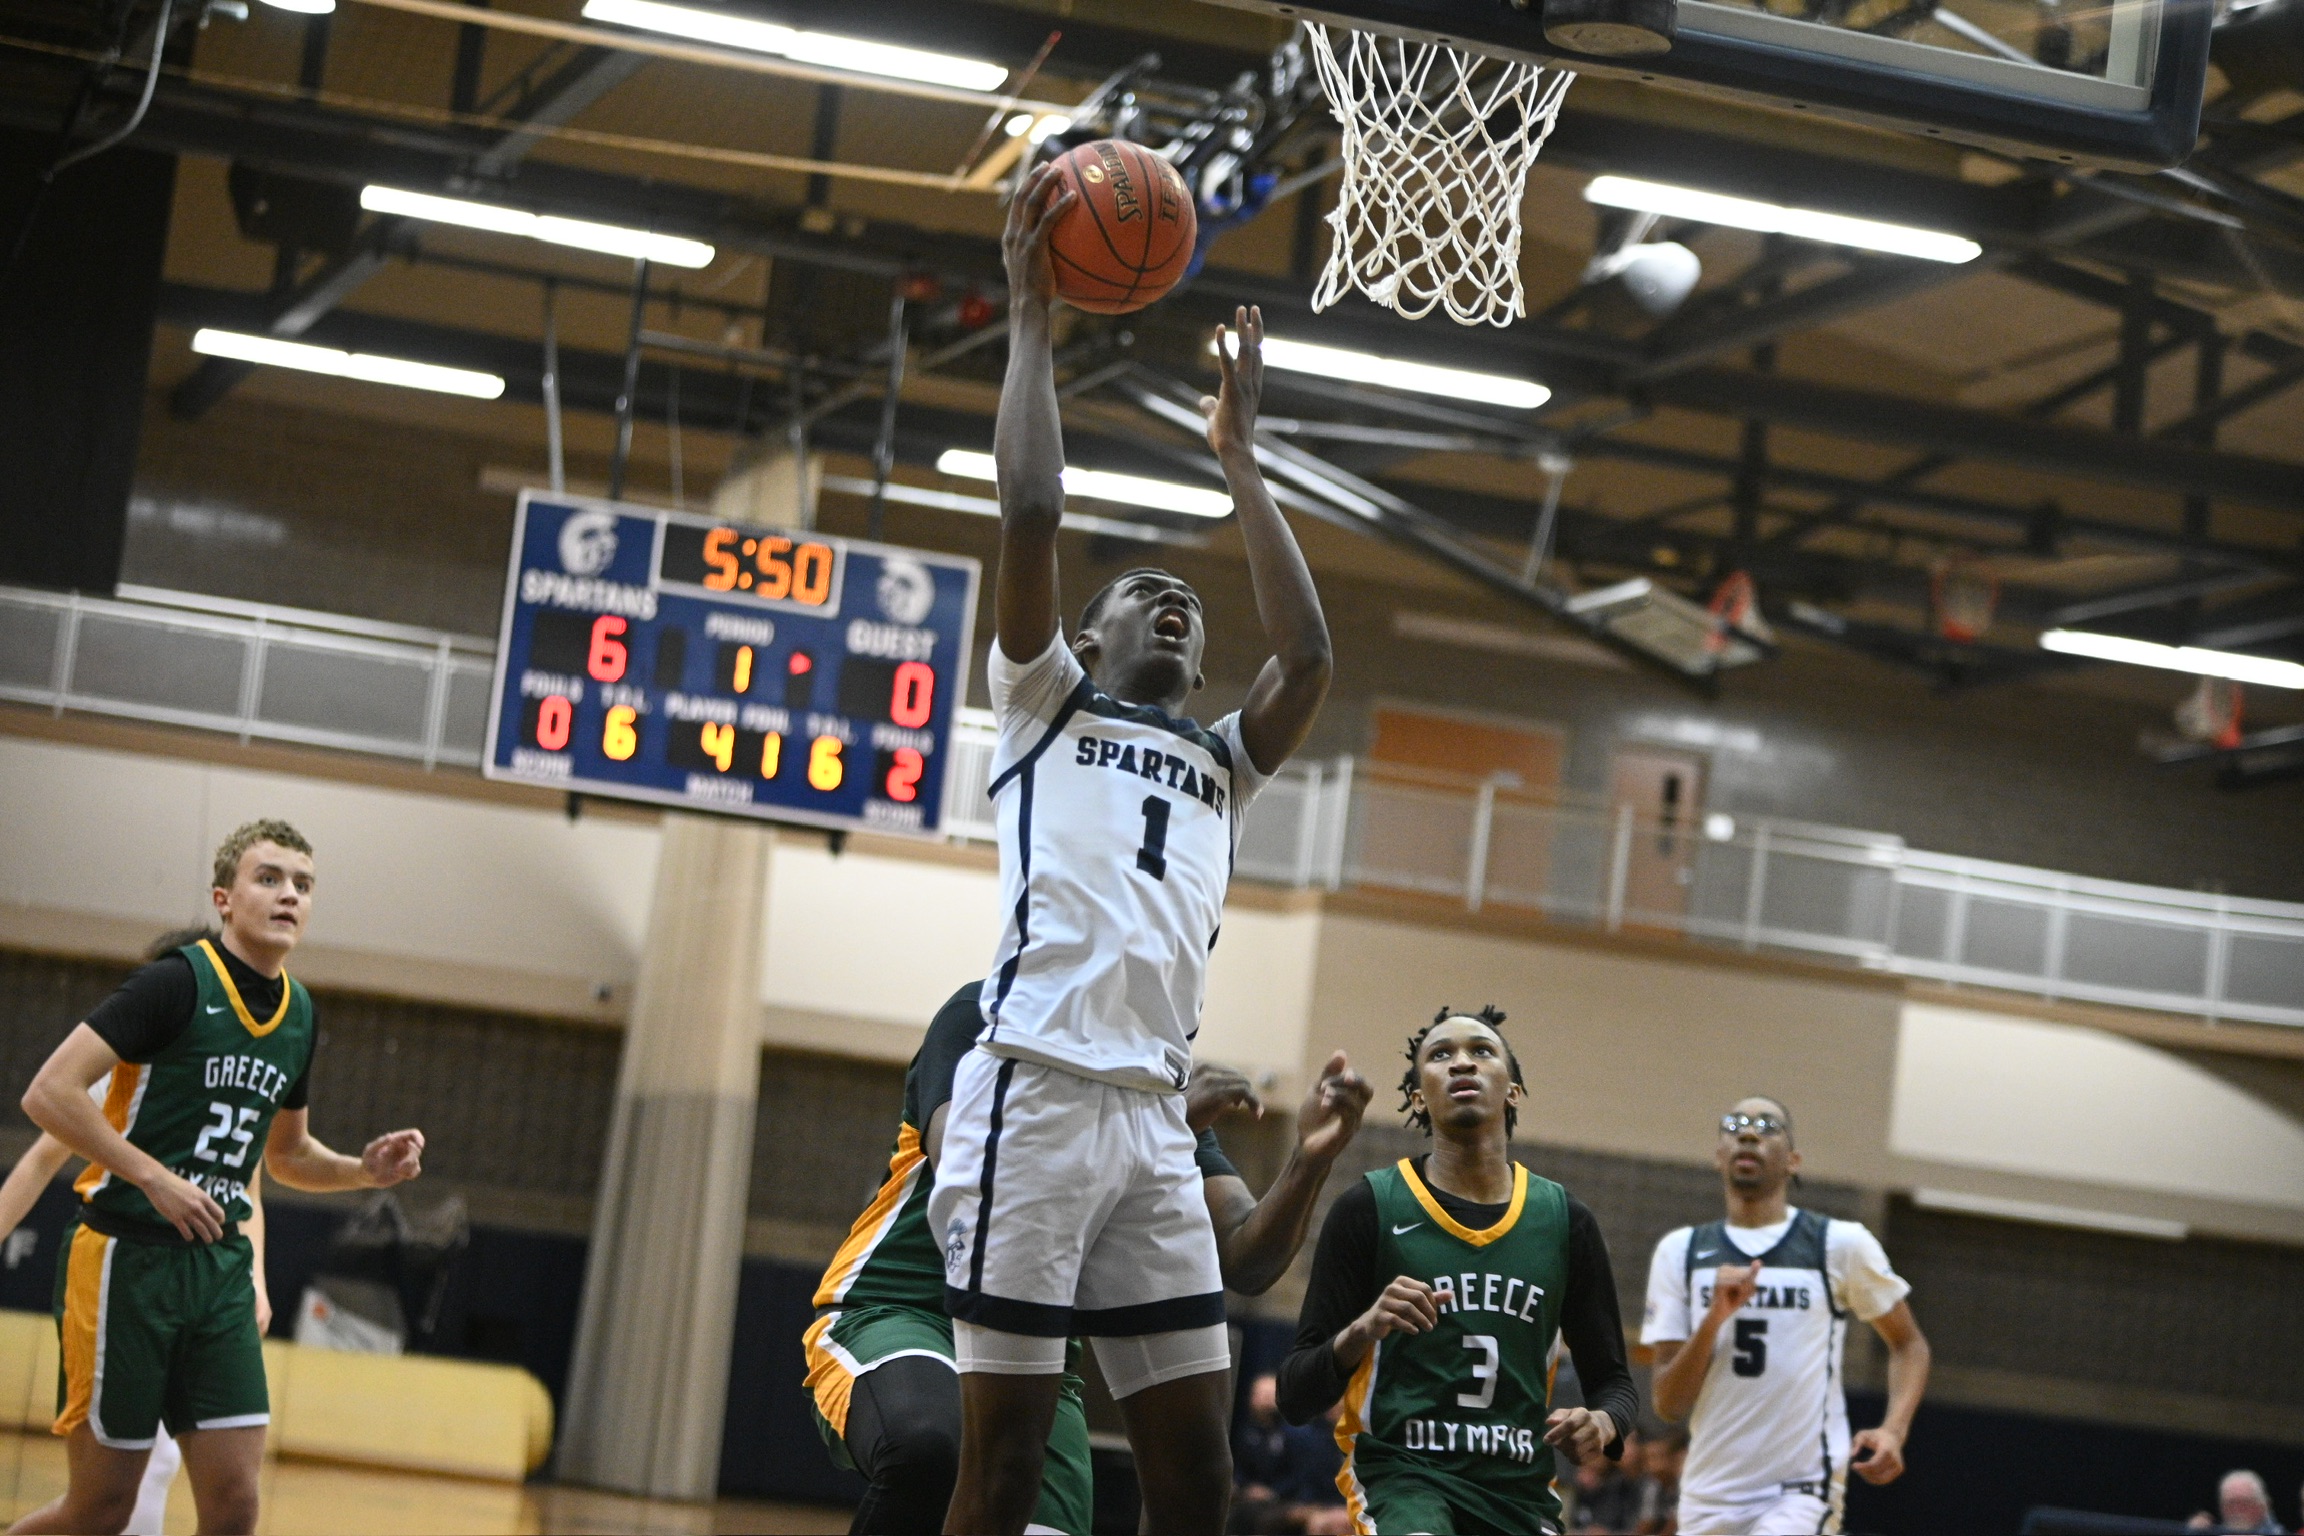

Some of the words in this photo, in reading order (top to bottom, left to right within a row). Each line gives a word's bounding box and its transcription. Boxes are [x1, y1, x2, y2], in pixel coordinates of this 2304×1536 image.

[703, 527, 833, 606] 5:50
[521, 568, 659, 621] SPARTANS
[588, 614, 628, 683] 6
[704, 612, 775, 647] PERIOD
[847, 618, 937, 662] GUEST
[733, 645, 753, 693] 1
[890, 661, 934, 729] 0
[537, 695, 572, 750] 0
[603, 704, 636, 761] 6
[664, 691, 738, 725] PLAYER
[808, 735, 842, 791] 6
[886, 747, 923, 802] 2
[1076, 736, 1225, 820] SPARTANS
[1136, 794, 1171, 882] 1
[205, 1055, 287, 1104] GREECE
[194, 1101, 260, 1168] 25
[1434, 1273, 1545, 1324] REECE
[1700, 1285, 1810, 1310] STANS
[1456, 1335, 1499, 1409] 3
[1732, 1318, 1768, 1377] 5
